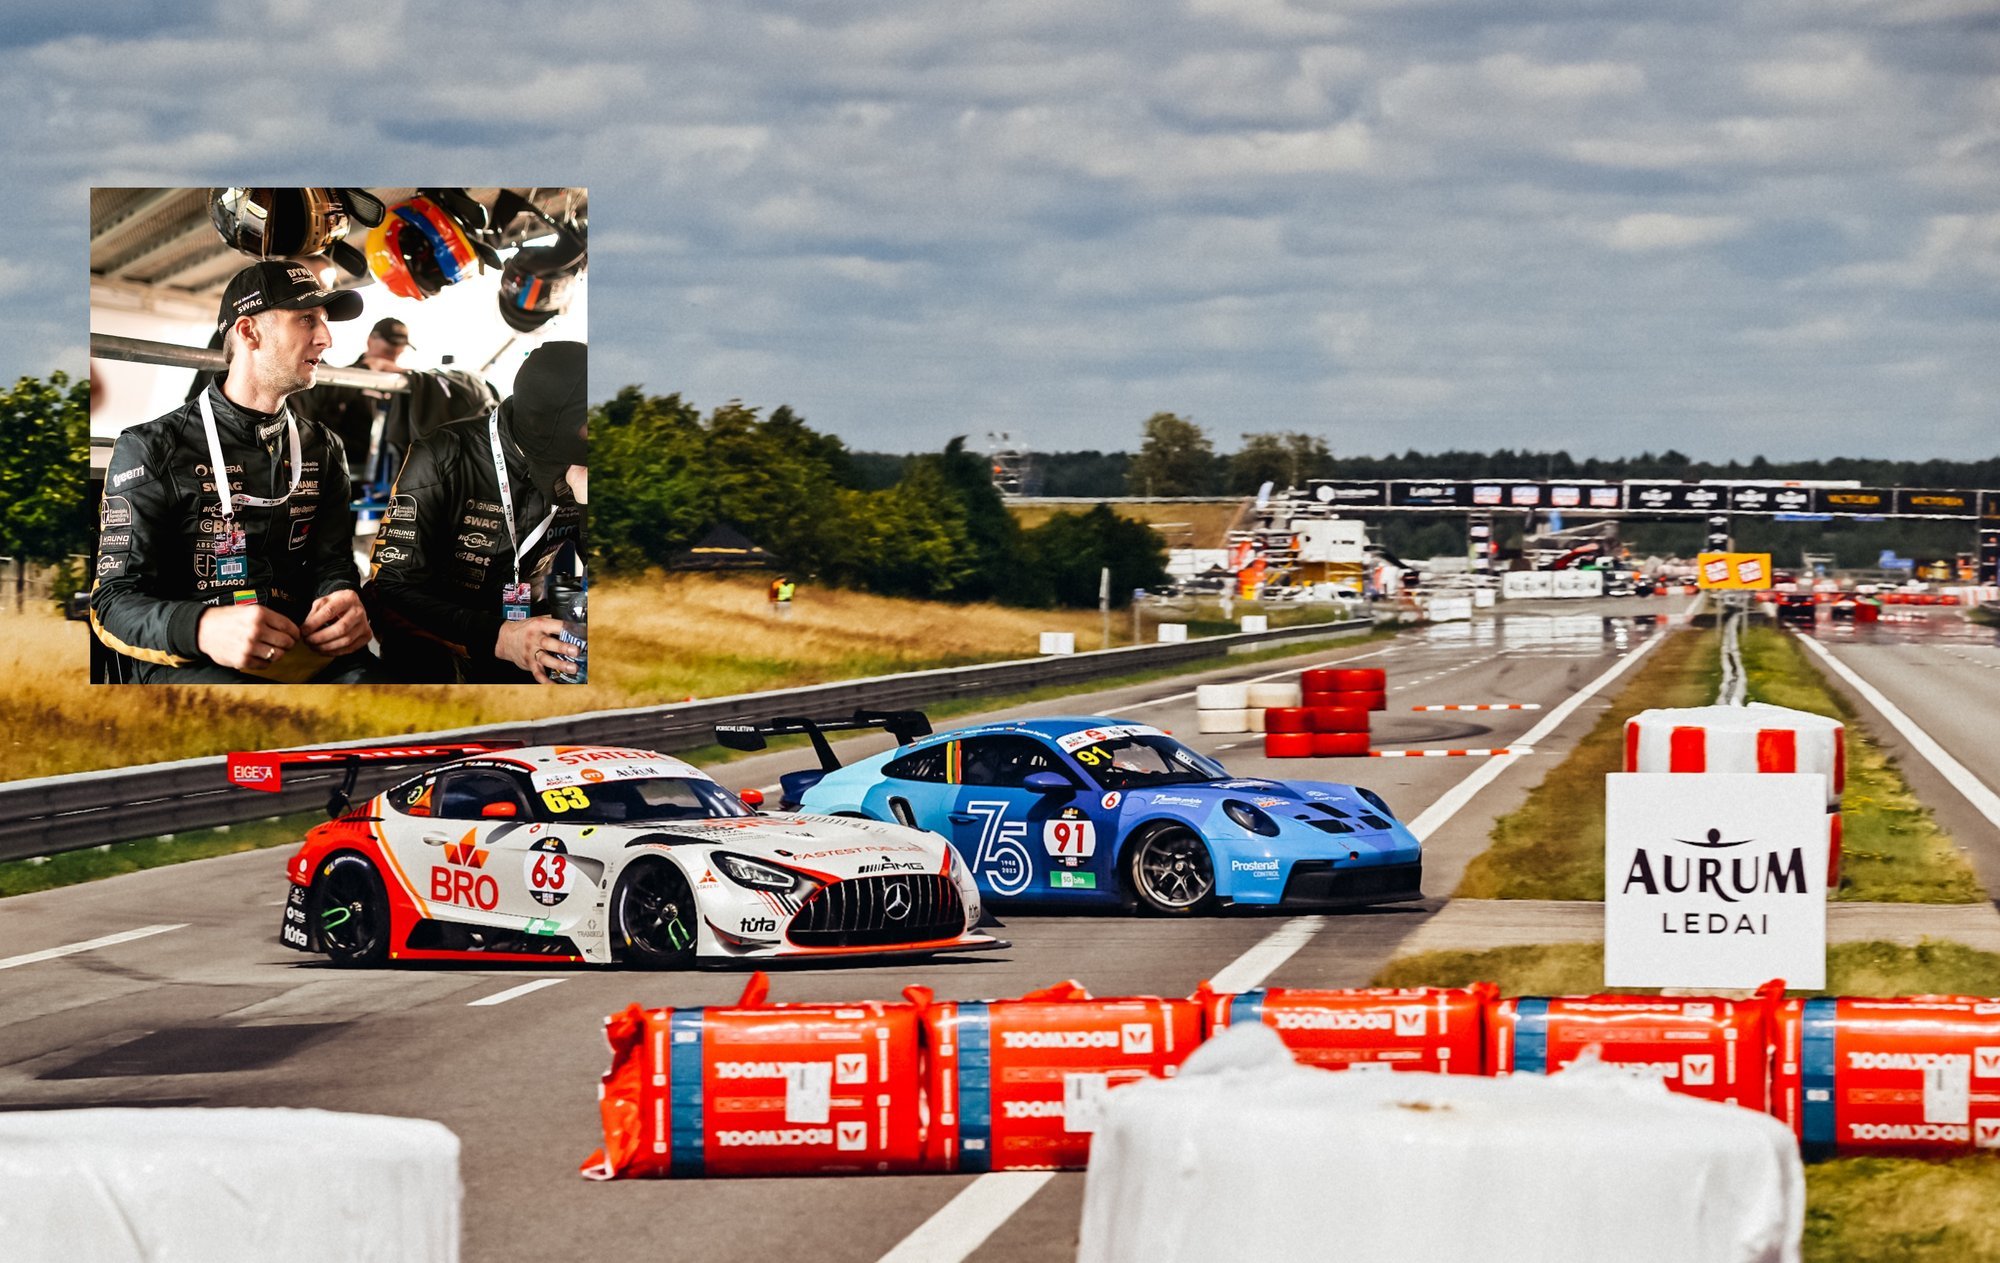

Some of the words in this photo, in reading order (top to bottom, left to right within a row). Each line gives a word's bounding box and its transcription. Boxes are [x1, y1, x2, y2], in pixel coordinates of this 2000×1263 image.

[237, 298, 263, 314] SWAG
[112, 464, 145, 488] freem
[464, 515, 497, 530] SWAG
[209, 579, 245, 588] TEXACO
[1077, 746, 1112, 766] 91
[541, 786, 590, 813] 63
[1105, 791, 1117, 808] 6
[1054, 823, 1085, 853] 91
[793, 847, 861, 861] FASTEST
[967, 801, 1033, 896] 75
[531, 853, 567, 889] 63
[881, 862, 924, 871] AMG
[1231, 859, 1279, 871] Prostenal
[1623, 847, 1808, 902] AURUM
[431, 865, 499, 911] BRO
[1663, 913, 1768, 935] LEDAI
[1274, 1012, 1392, 1030] ROCKWOOL
[1001, 1030, 1119, 1049] ROCKWOOL
[714, 1061, 833, 1079] KWOOL
[716, 1128, 833, 1146] ROCKWOOL
[1849, 1123, 1970, 1141] ROCKWOOL
